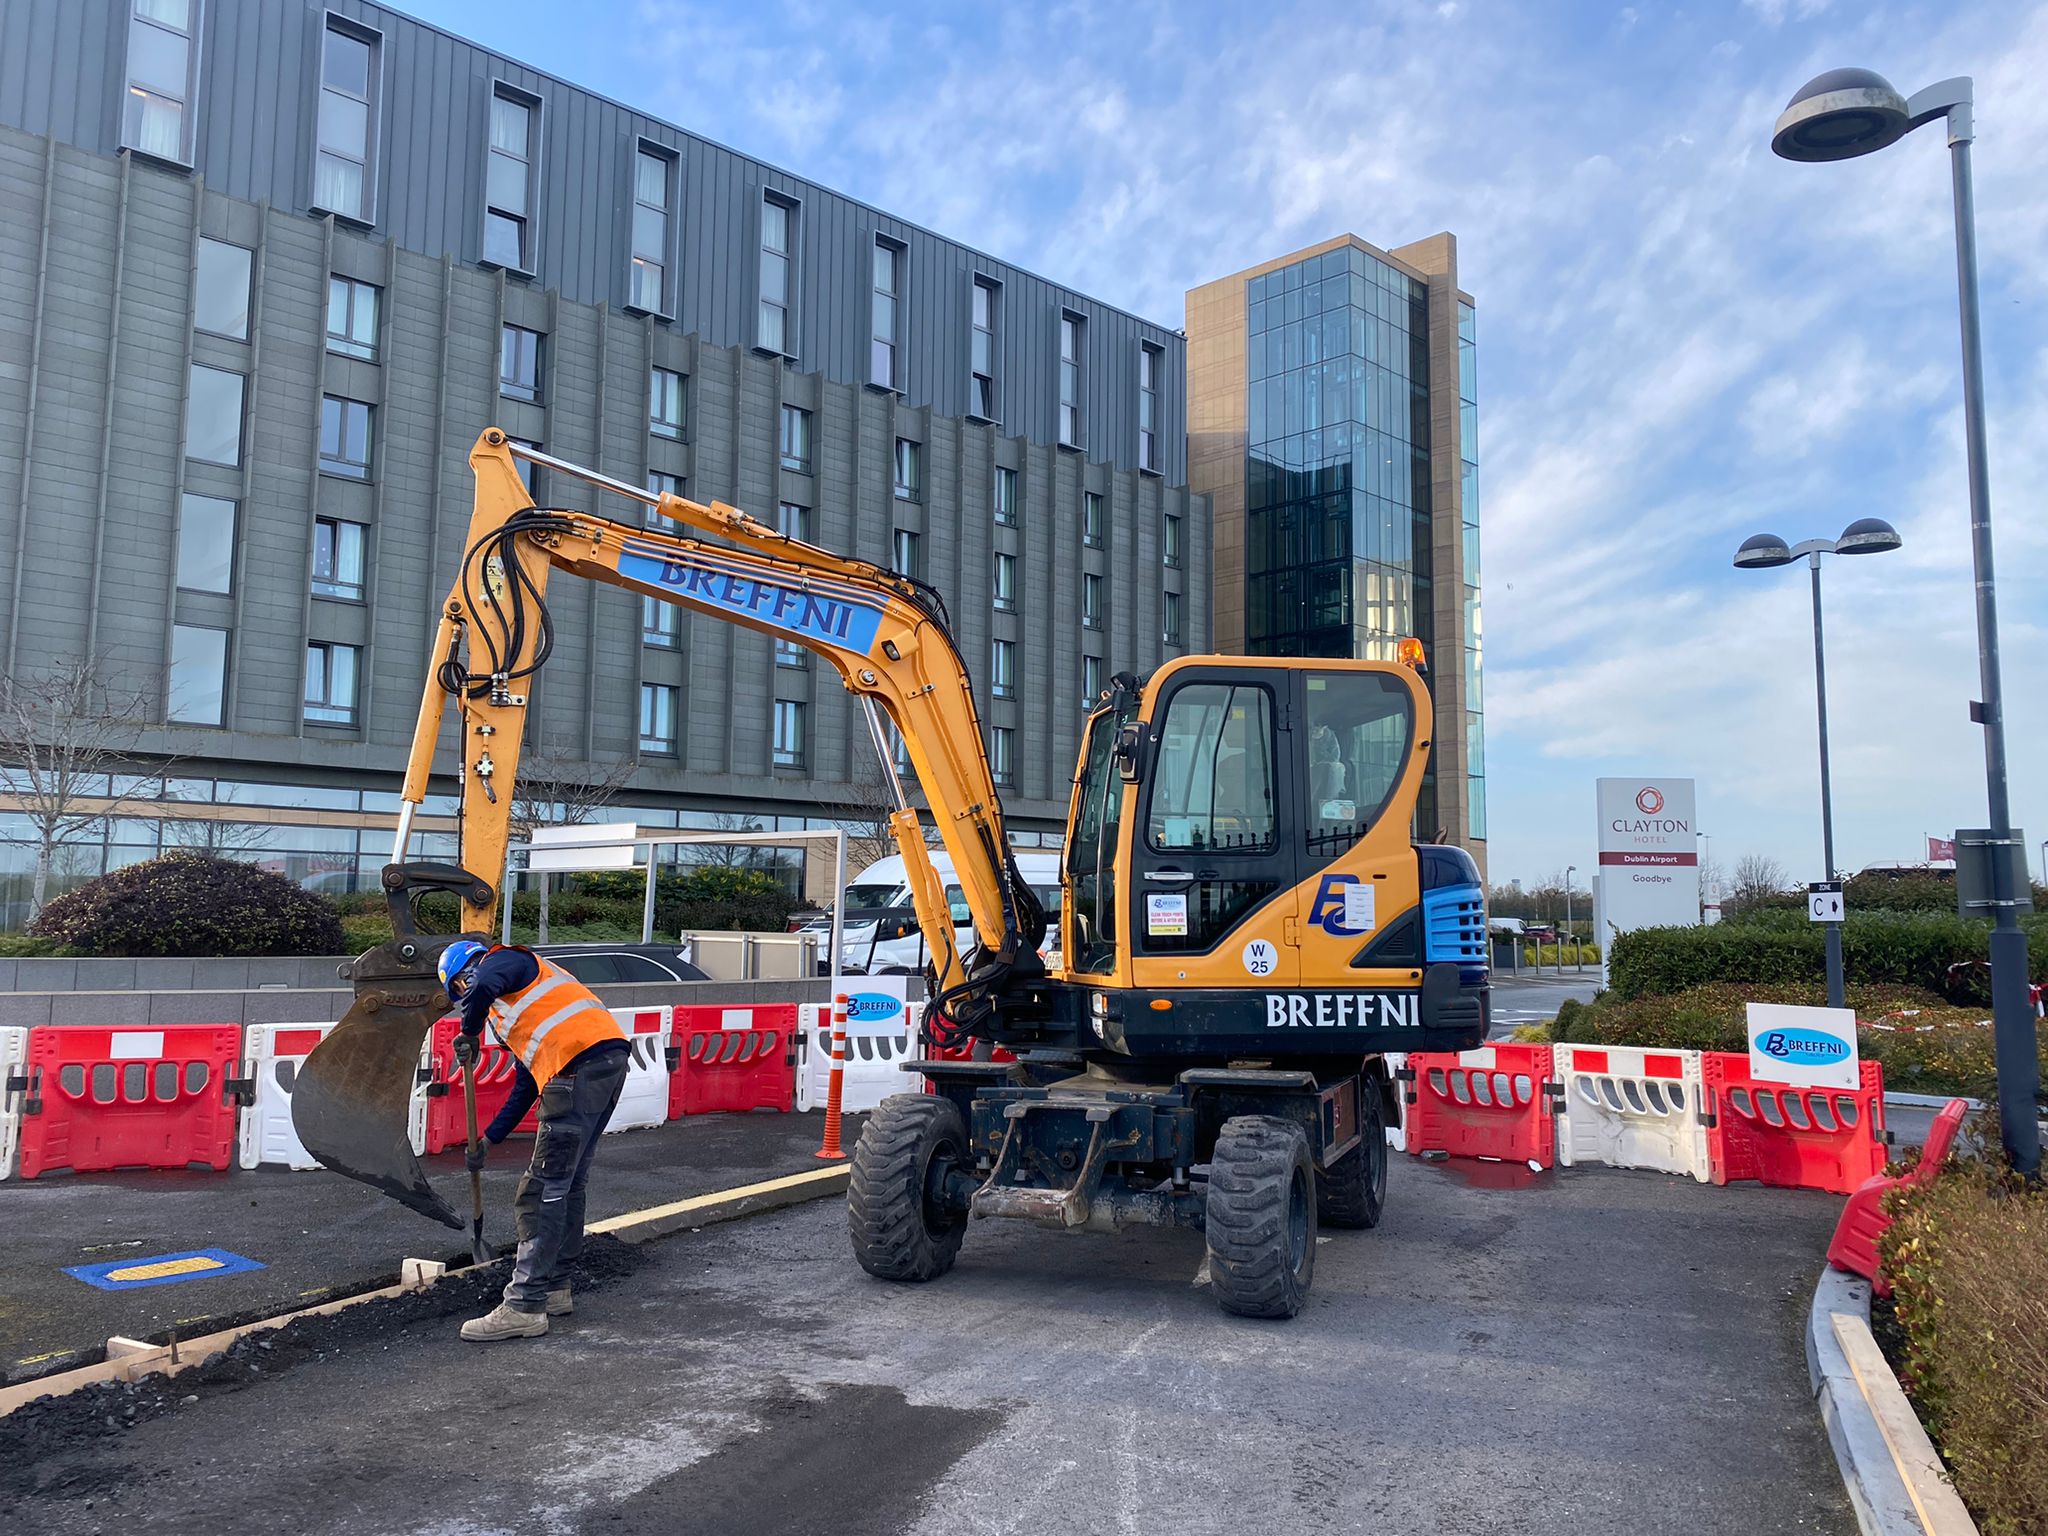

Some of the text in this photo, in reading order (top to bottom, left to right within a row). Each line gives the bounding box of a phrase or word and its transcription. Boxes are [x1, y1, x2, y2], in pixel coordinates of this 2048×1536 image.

[659, 552, 853, 639] BREFFNI
[1612, 819, 1688, 832] CLAYTON
[1650, 855, 1678, 864] Airport
[1632, 873, 1672, 884] Goodbye
[1819, 883, 1831, 891] ZONE
[1813, 897, 1824, 917] C
[1251, 944, 1265, 956] W
[1251, 961, 1268, 973] 25
[860, 1002, 896, 1010] BREFFNI
[1265, 994, 1420, 1027] BREFFNI
[1788, 1040, 1842, 1054] BREFFNI
